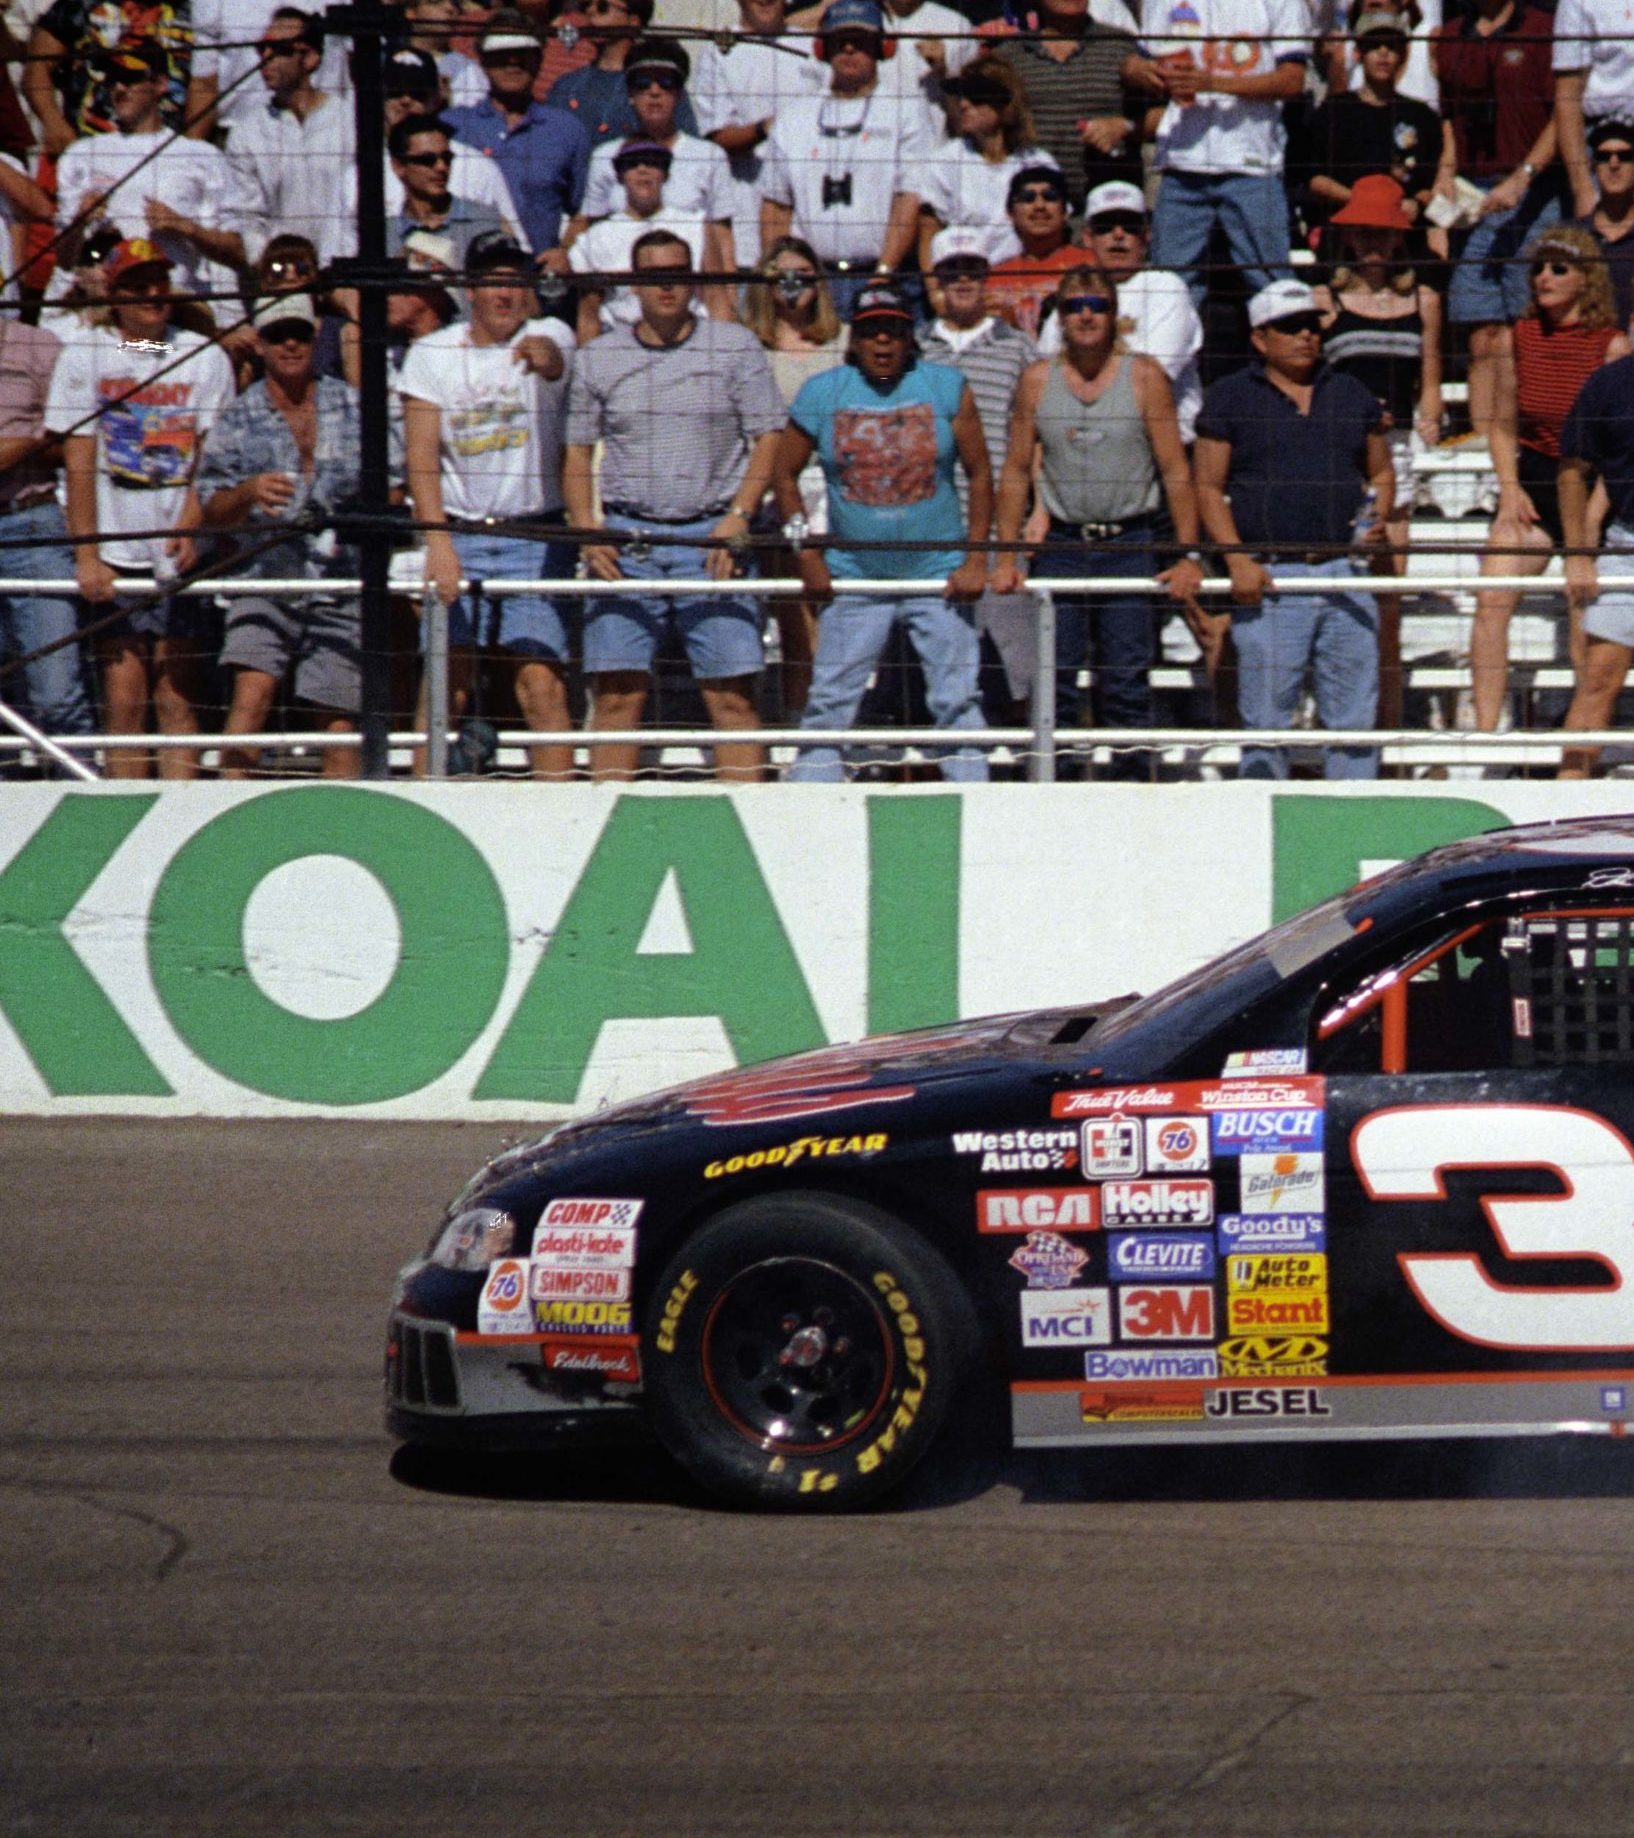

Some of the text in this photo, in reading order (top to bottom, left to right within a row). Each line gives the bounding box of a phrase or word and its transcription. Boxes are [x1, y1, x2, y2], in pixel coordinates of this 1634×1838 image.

[1201, 1088, 1307, 1104] Winston Cup
[1217, 1111, 1317, 1137] BUSCH
[953, 1129, 1077, 1153] Western
[1164, 1130, 1191, 1150] 76
[704, 1132, 889, 1178] GOODYEAR
[981, 1150, 1049, 1172] Auto
[547, 1203, 612, 1225] COMP
[987, 1193, 1091, 1227] RCA
[1105, 1184, 1209, 1222] Holley
[1222, 1216, 1323, 1240] Goody's
[1117, 1236, 1206, 1266] CLEVITE
[1259, 1258, 1311, 1273] Auto
[493, 1273, 518, 1298] 76
[539, 1271, 619, 1295] SIMPSON
[1253, 1273, 1321, 1289] Meter
[536, 1301, 632, 1325] MOOG
[657, 1269, 699, 1353] EAGLE
[1125, 1289, 1211, 1336] 3M
[1232, 1297, 1323, 1325] Stant
[1029, 1316, 1093, 1337] MCI
[1087, 1352, 1215, 1379] Bowman
[1208, 1388, 1330, 1416] JESEL
